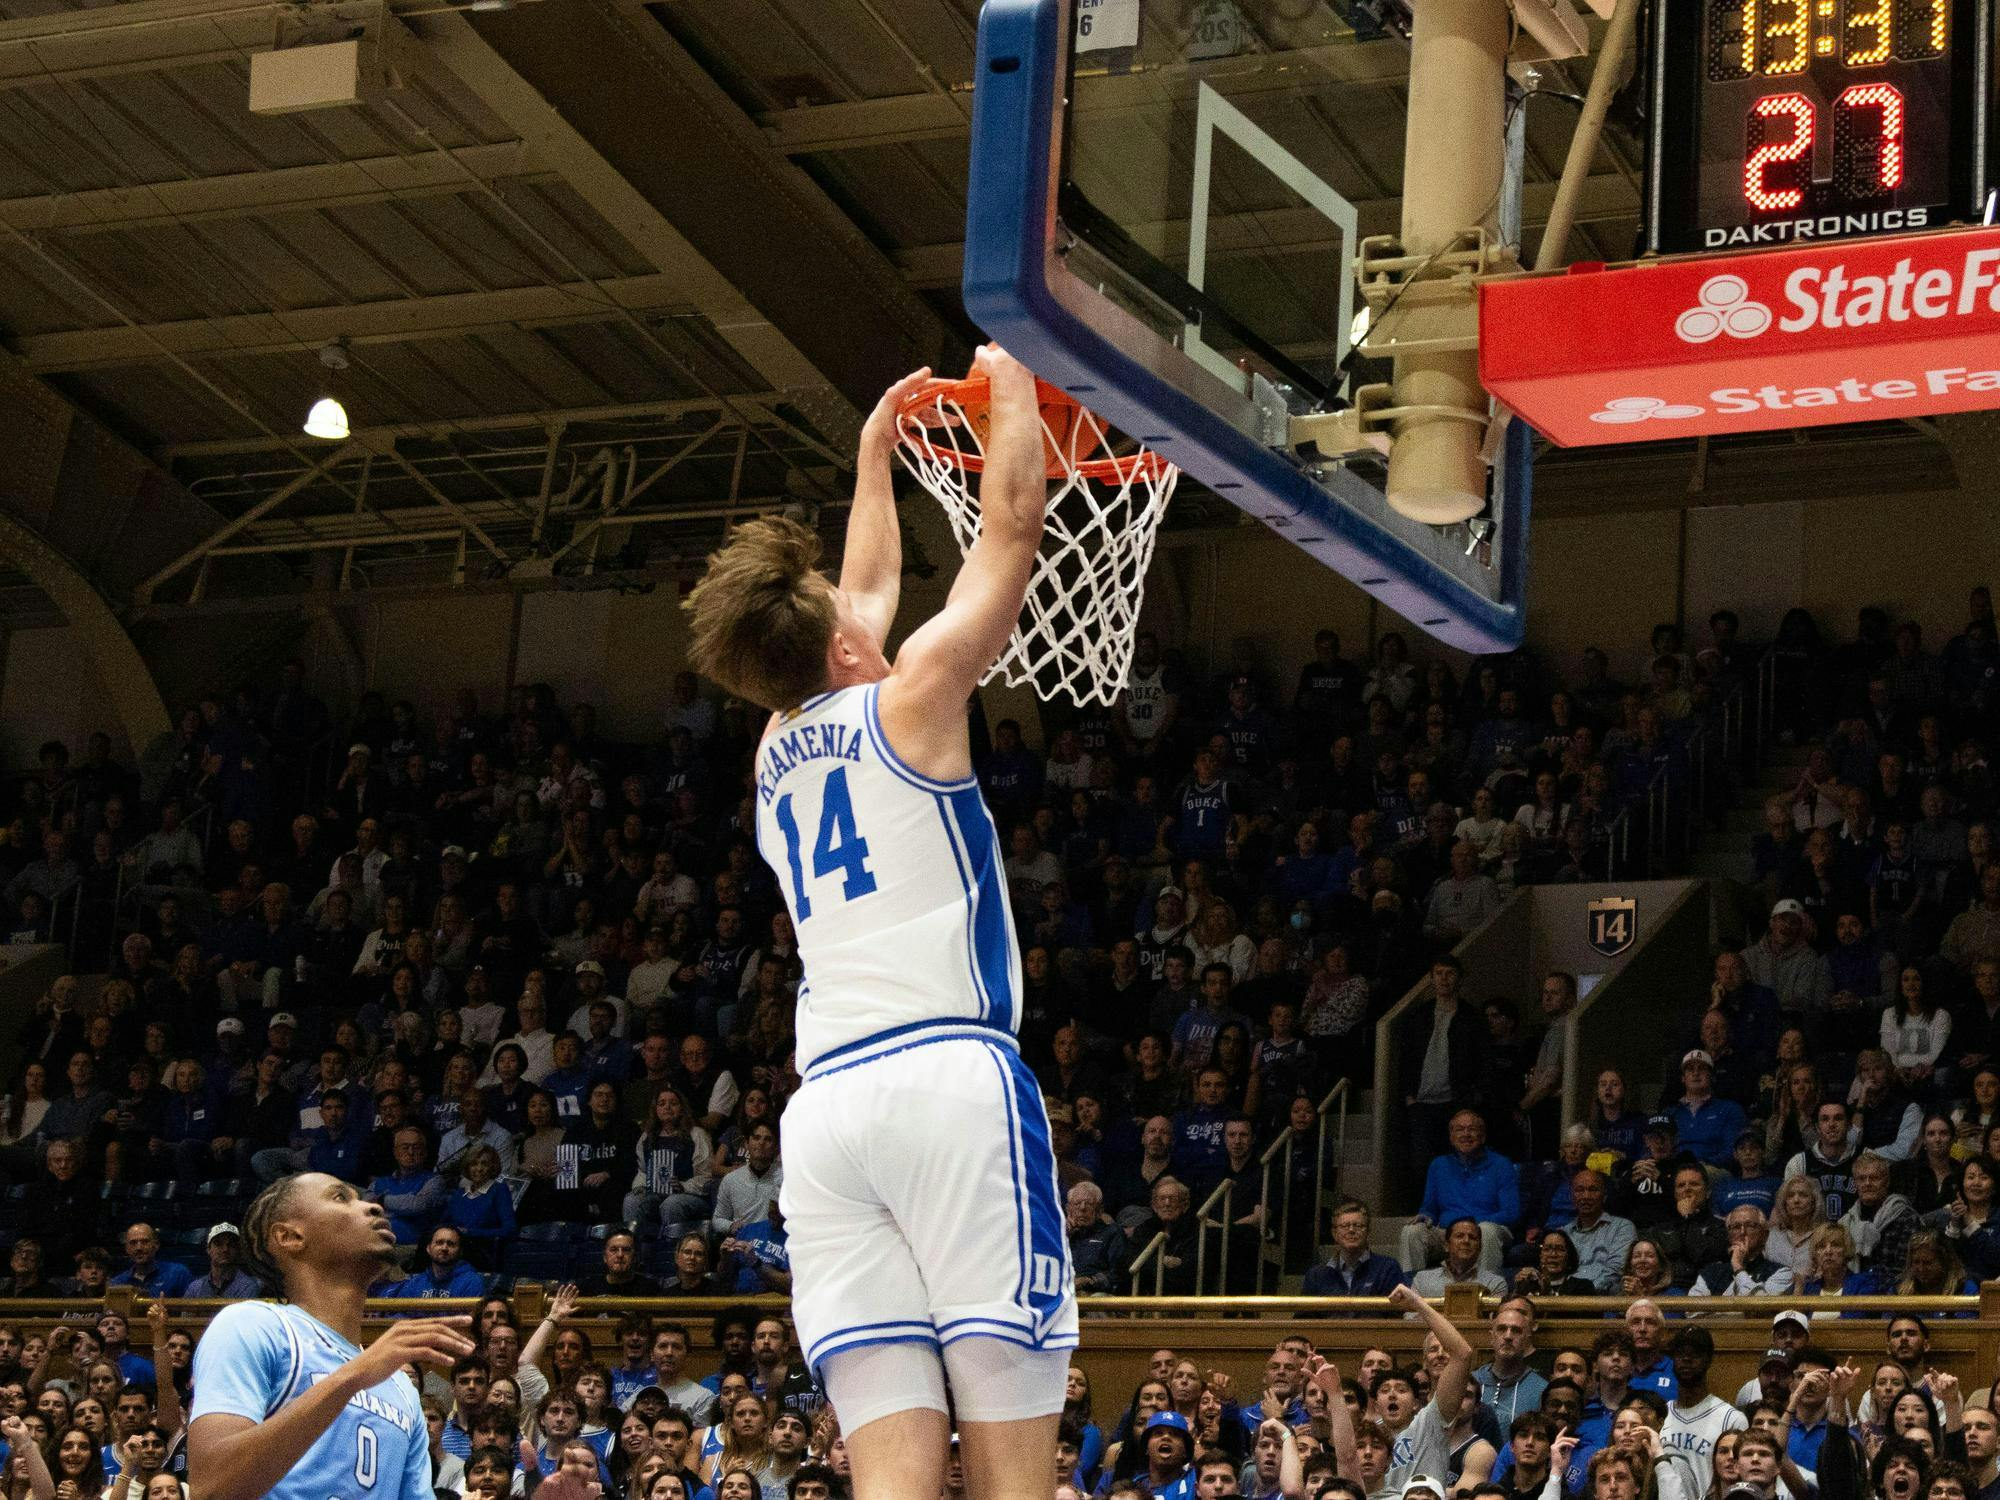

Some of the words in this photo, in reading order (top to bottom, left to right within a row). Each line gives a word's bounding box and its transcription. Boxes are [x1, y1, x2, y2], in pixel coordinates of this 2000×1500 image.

[1745, 84, 1902, 211] 27
[1704, 207, 1928, 248] DAKTRONICS
[1779, 257, 1953, 333] State
[1956, 247, 2000, 316] F
[1709, 377, 1917, 414] State
[1231, 731, 1258, 746] UKE
[1186, 797, 1220, 811] DUKE
[775, 765, 878, 925] 14
[1595, 913, 1628, 945] 14
[1820, 1174, 1858, 1195] UKE
[1030, 1252, 1061, 1297] D
[354, 1423, 379, 1492] 0
